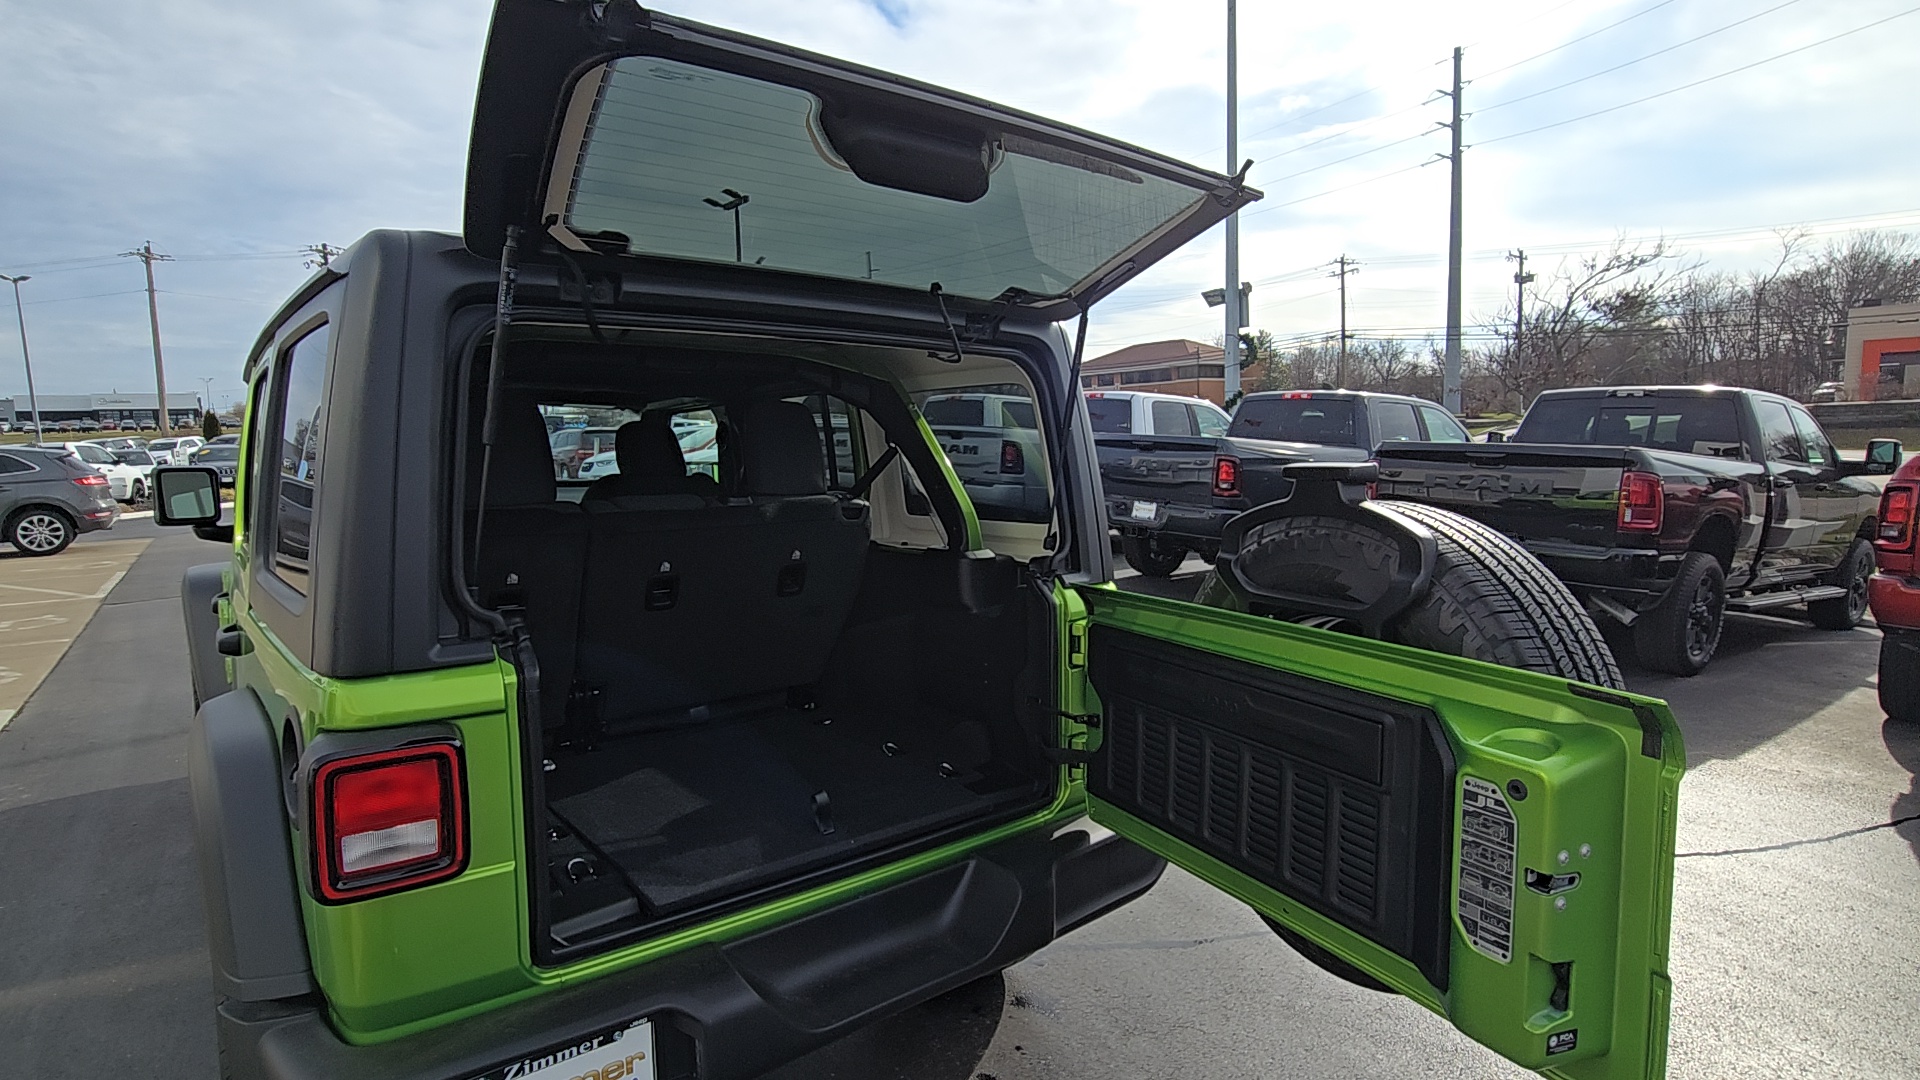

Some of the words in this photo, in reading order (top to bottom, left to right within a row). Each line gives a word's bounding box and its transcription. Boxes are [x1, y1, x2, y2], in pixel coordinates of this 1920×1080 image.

[1423, 473, 1554, 495] RAM
[1471, 782, 1490, 793] Jeep
[1481, 914, 1508, 931] USA
[1559, 1032, 1575, 1042] FCA
[503, 1036, 604, 1080] Zimmer
